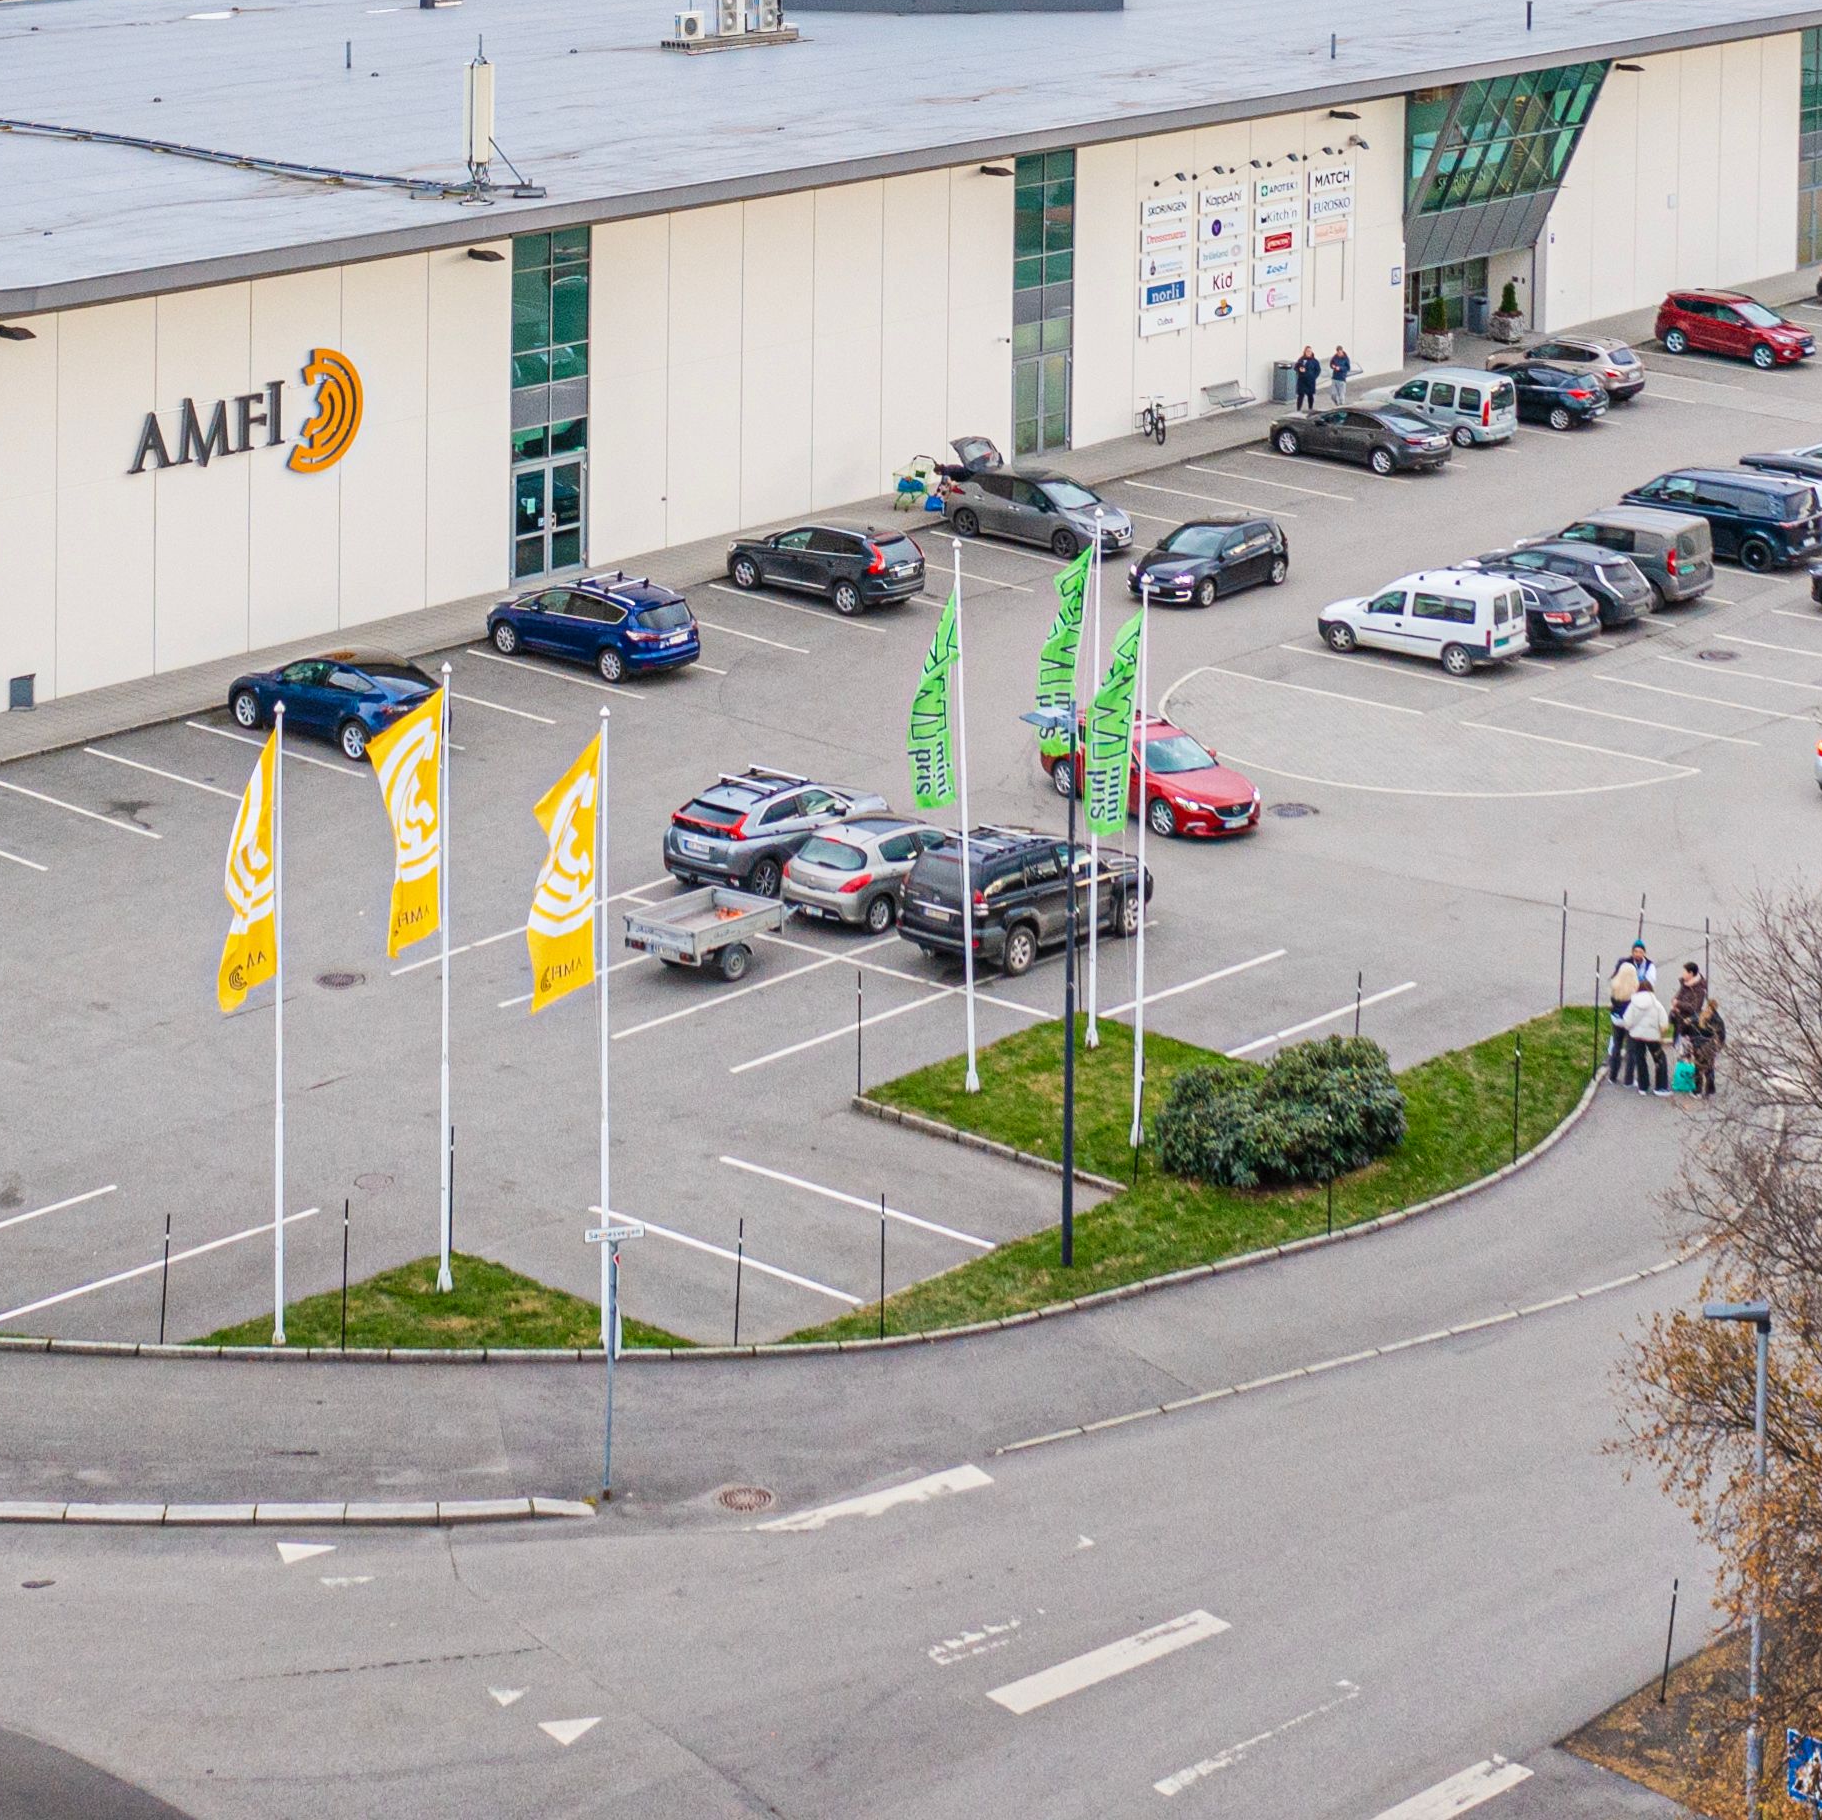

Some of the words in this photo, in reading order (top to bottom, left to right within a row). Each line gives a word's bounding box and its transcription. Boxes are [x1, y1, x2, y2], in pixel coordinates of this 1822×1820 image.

[1315, 170, 1350, 187] MATCH
[1269, 183, 1294, 194] APOTEK
[1148, 201, 1187, 217] SKORINGEN
[1313, 197, 1351, 214] EUROSKO
[1146, 231, 1186, 245] Dressmann
[1212, 272, 1233, 291] Kid
[1152, 284, 1180, 303] norli
[126, 380, 286, 475] AMFI
[907, 748, 932, 796] pris
[936, 741, 952, 797] mini
[1087, 769, 1108, 821] pris
[1107, 765, 1123, 824] mini
